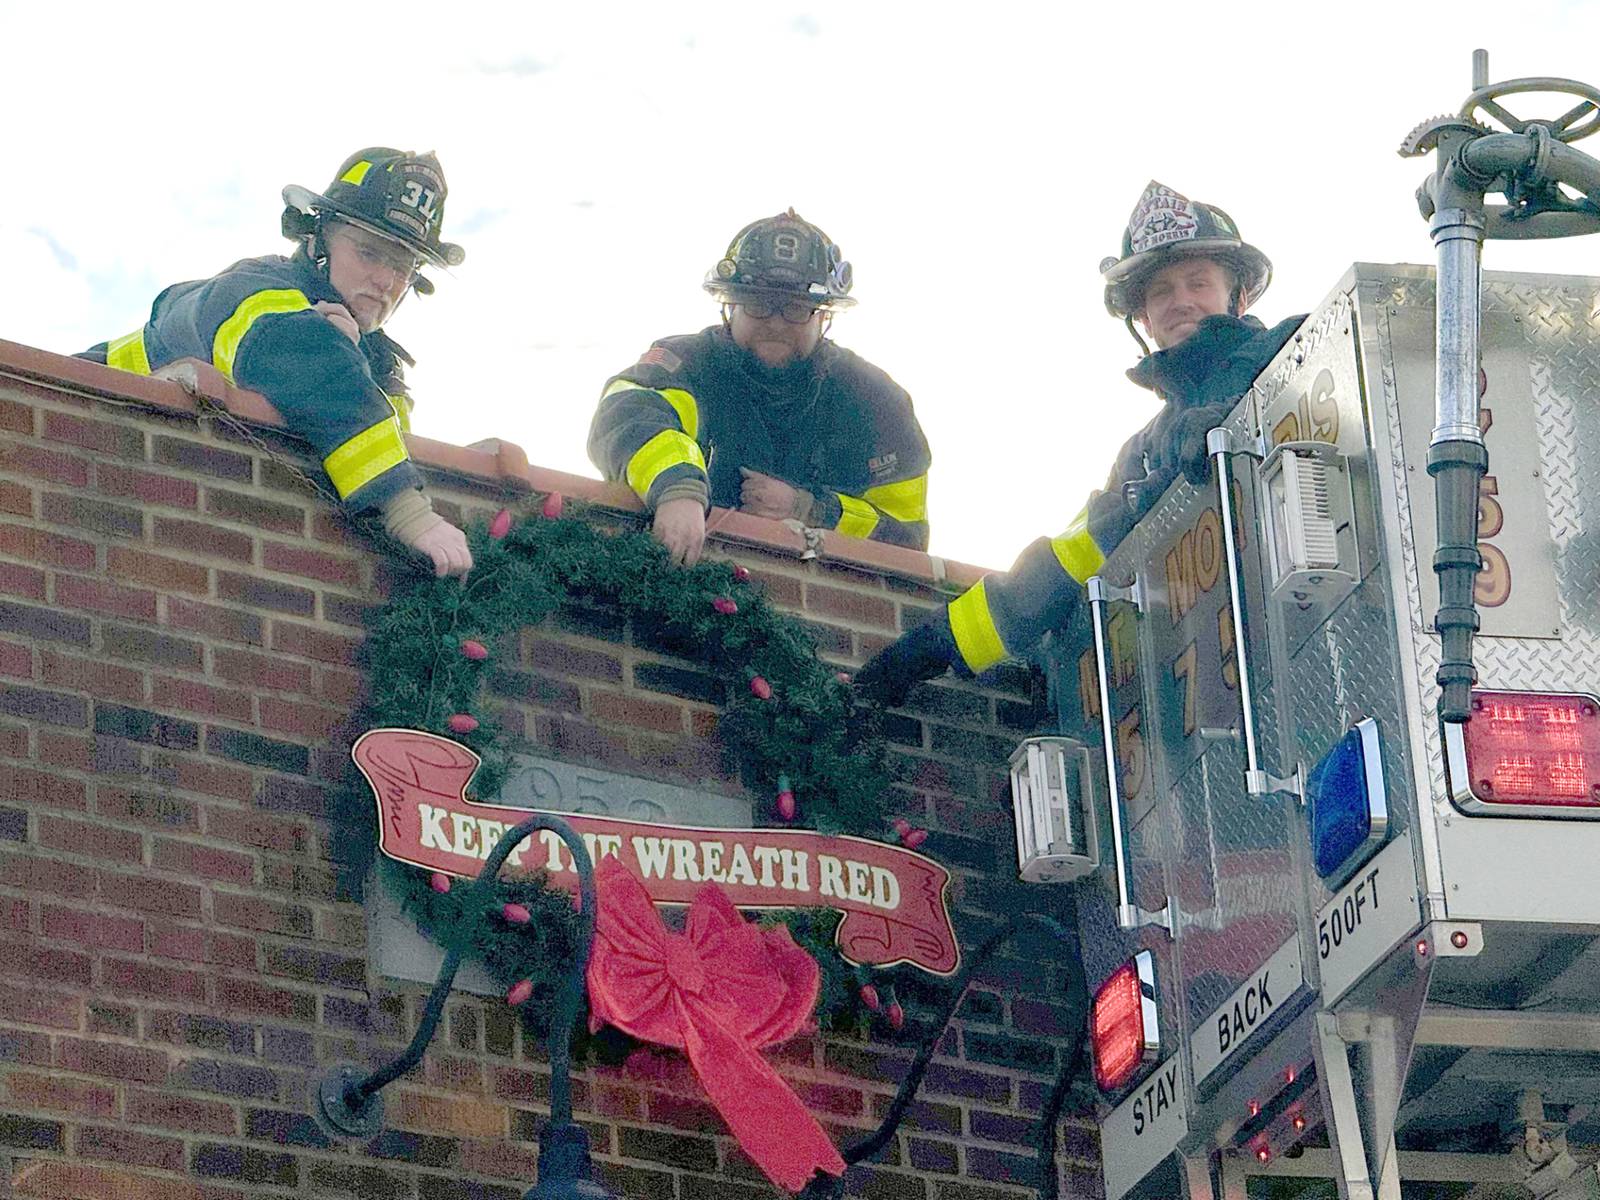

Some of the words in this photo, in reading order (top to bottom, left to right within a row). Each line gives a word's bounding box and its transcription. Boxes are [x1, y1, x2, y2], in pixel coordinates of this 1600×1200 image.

[400, 179, 437, 220] 31
[631, 836, 809, 893] WREATH
[819, 855, 900, 910] RED
[1131, 1064, 1181, 1136] STAY
[1216, 970, 1275, 1055] BACK
[1318, 867, 1381, 960] 500FT
